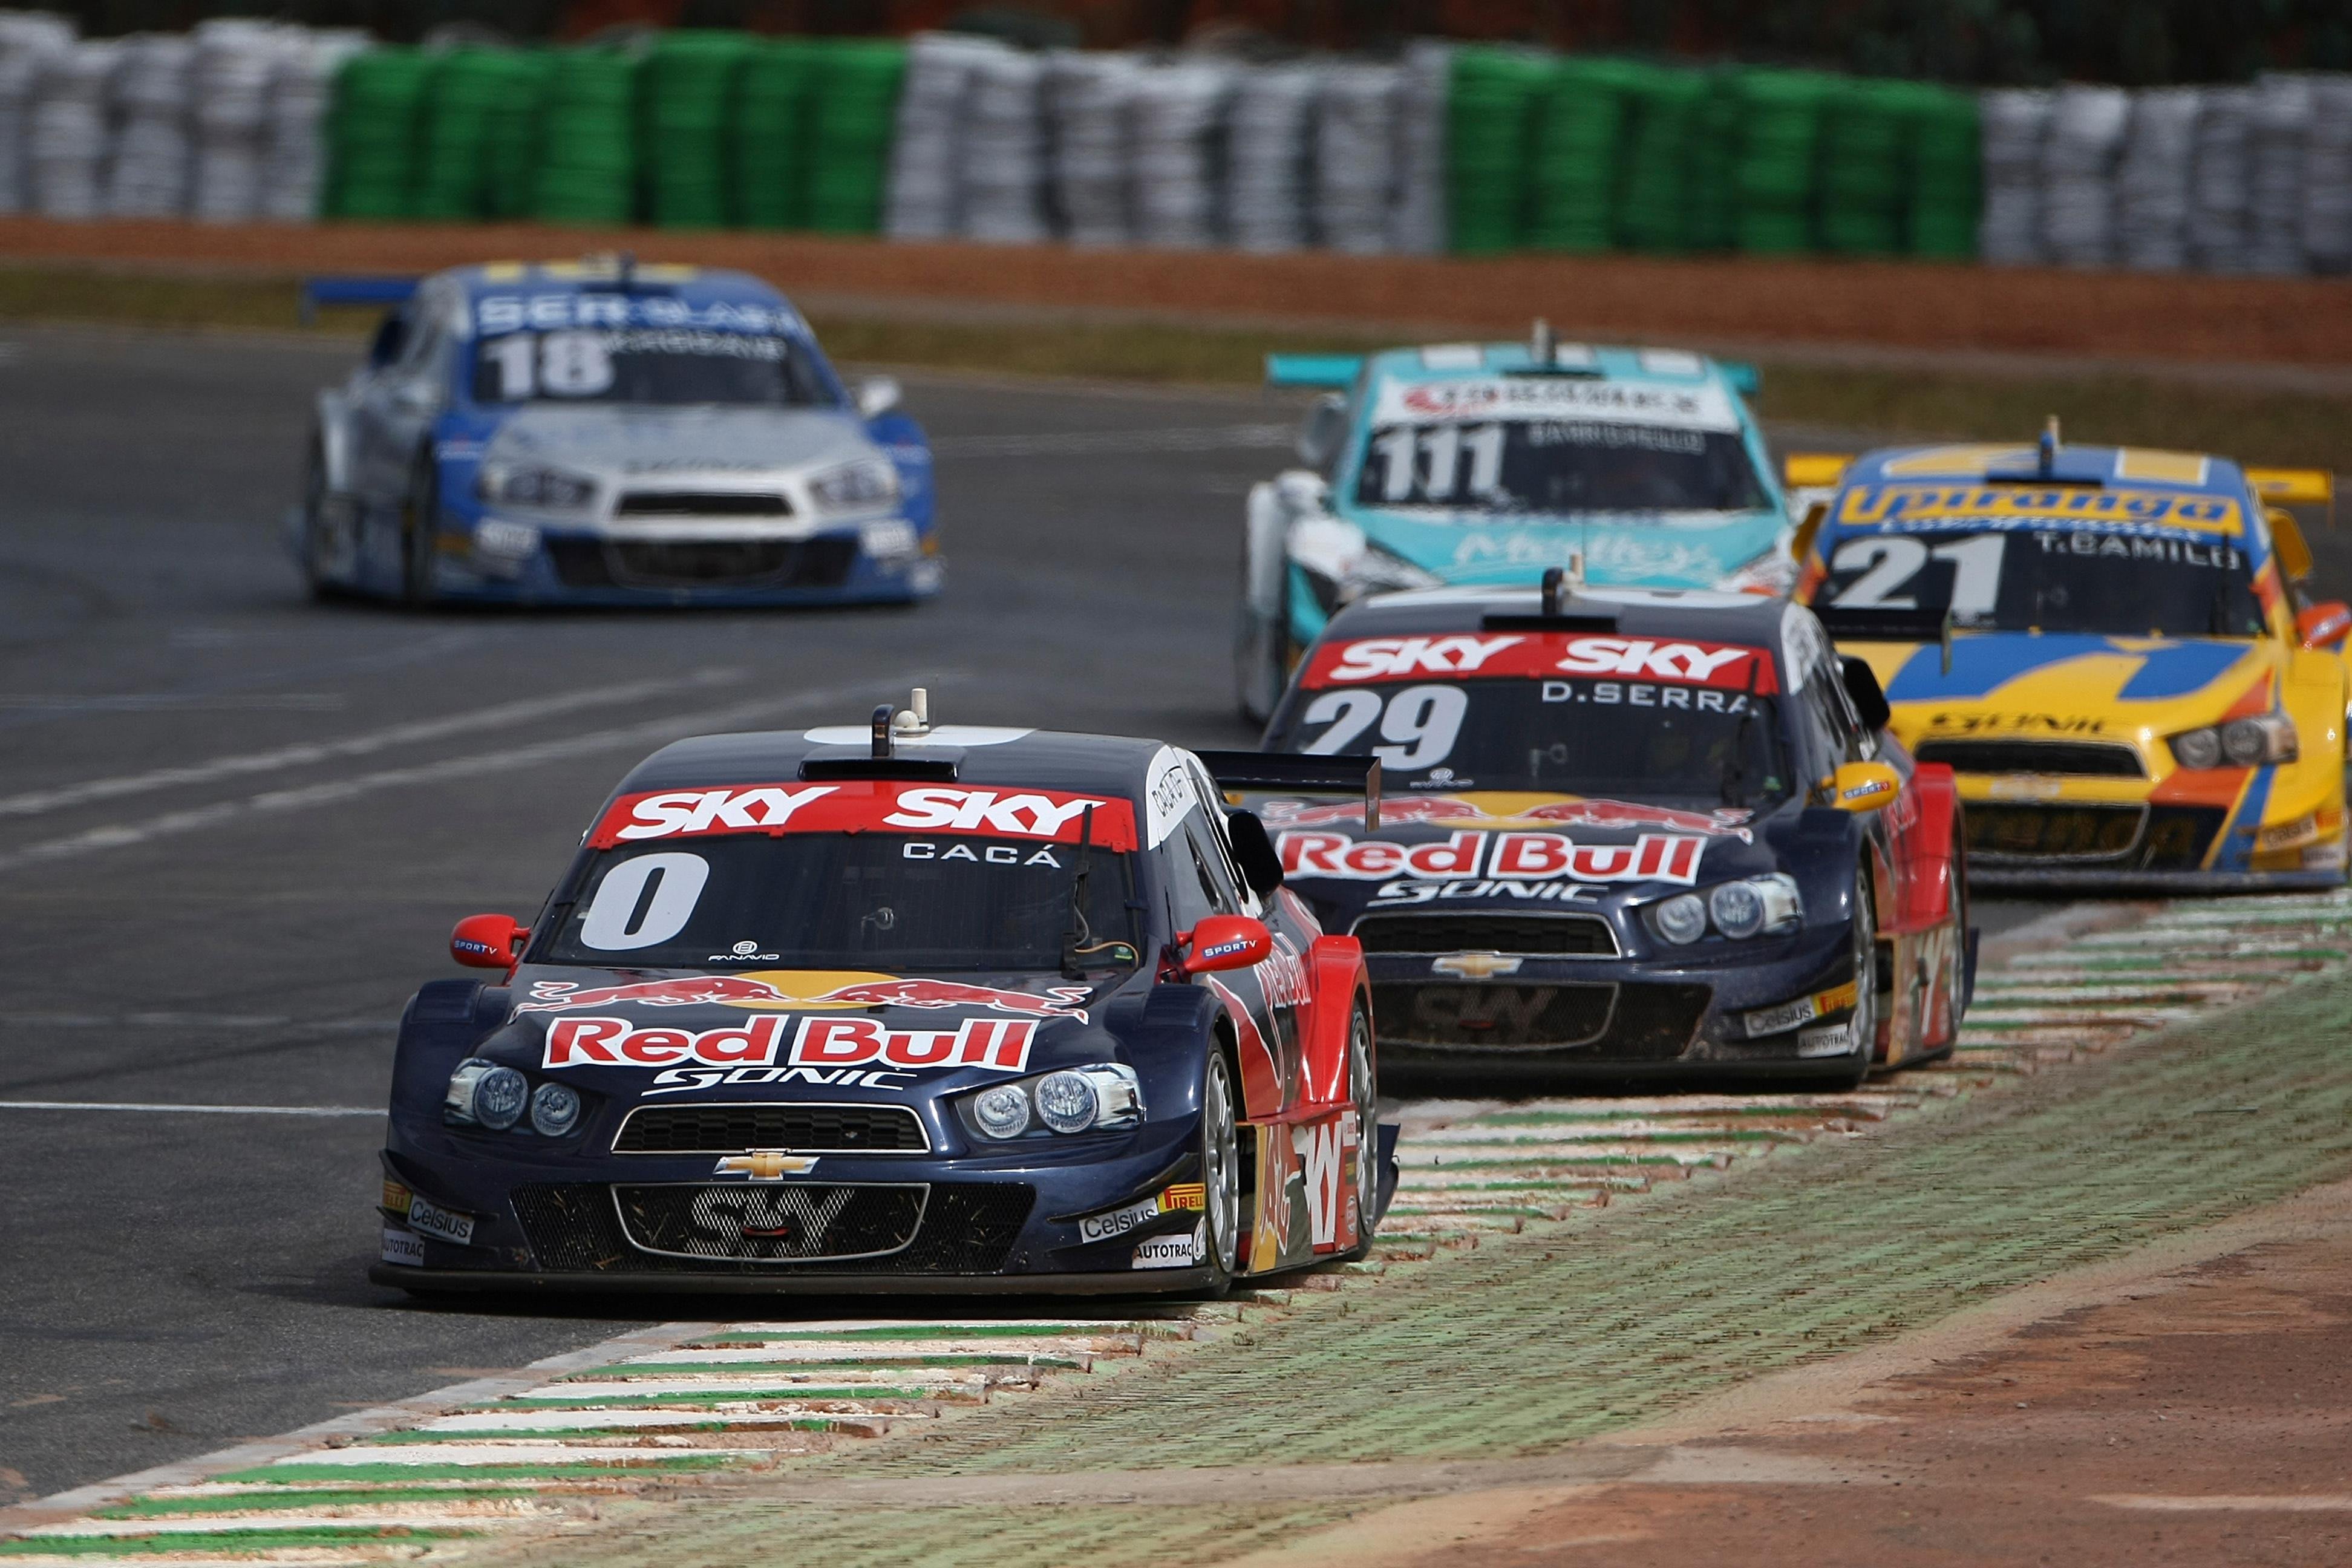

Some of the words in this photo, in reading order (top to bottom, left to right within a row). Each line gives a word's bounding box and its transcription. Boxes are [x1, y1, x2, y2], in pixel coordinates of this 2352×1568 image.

[486, 330, 613, 400] 18
[1376, 426, 1506, 501] 111
[1831, 534, 2007, 611] 21
[1330, 636, 1526, 681] SKY
[1555, 638, 1750, 680] SKY
[1542, 681, 1757, 716] D.SERRA
[1302, 685, 1469, 771] 29
[616, 786, 840, 839] SKY
[883, 788, 1108, 837] SKY
[903, 843, 1061, 868] CACÁ
[1274, 831, 1488, 881] Red
[1488, 832, 1708, 885] Bull
[580, 851, 710, 950] 0
[1367, 880, 1609, 906] SONIC
[454, 940, 497, 955] SPORTV
[1204, 939, 1257, 956] SPORTV
[541, 1014, 789, 1069] Red
[788, 1016, 1040, 1071] Bull
[642, 1067, 917, 1096] SONIC
[411, 1201, 469, 1238] Celsius
[685, 1187, 855, 1258] SKY
[1137, 1243, 1191, 1259] AUTOTRAC
